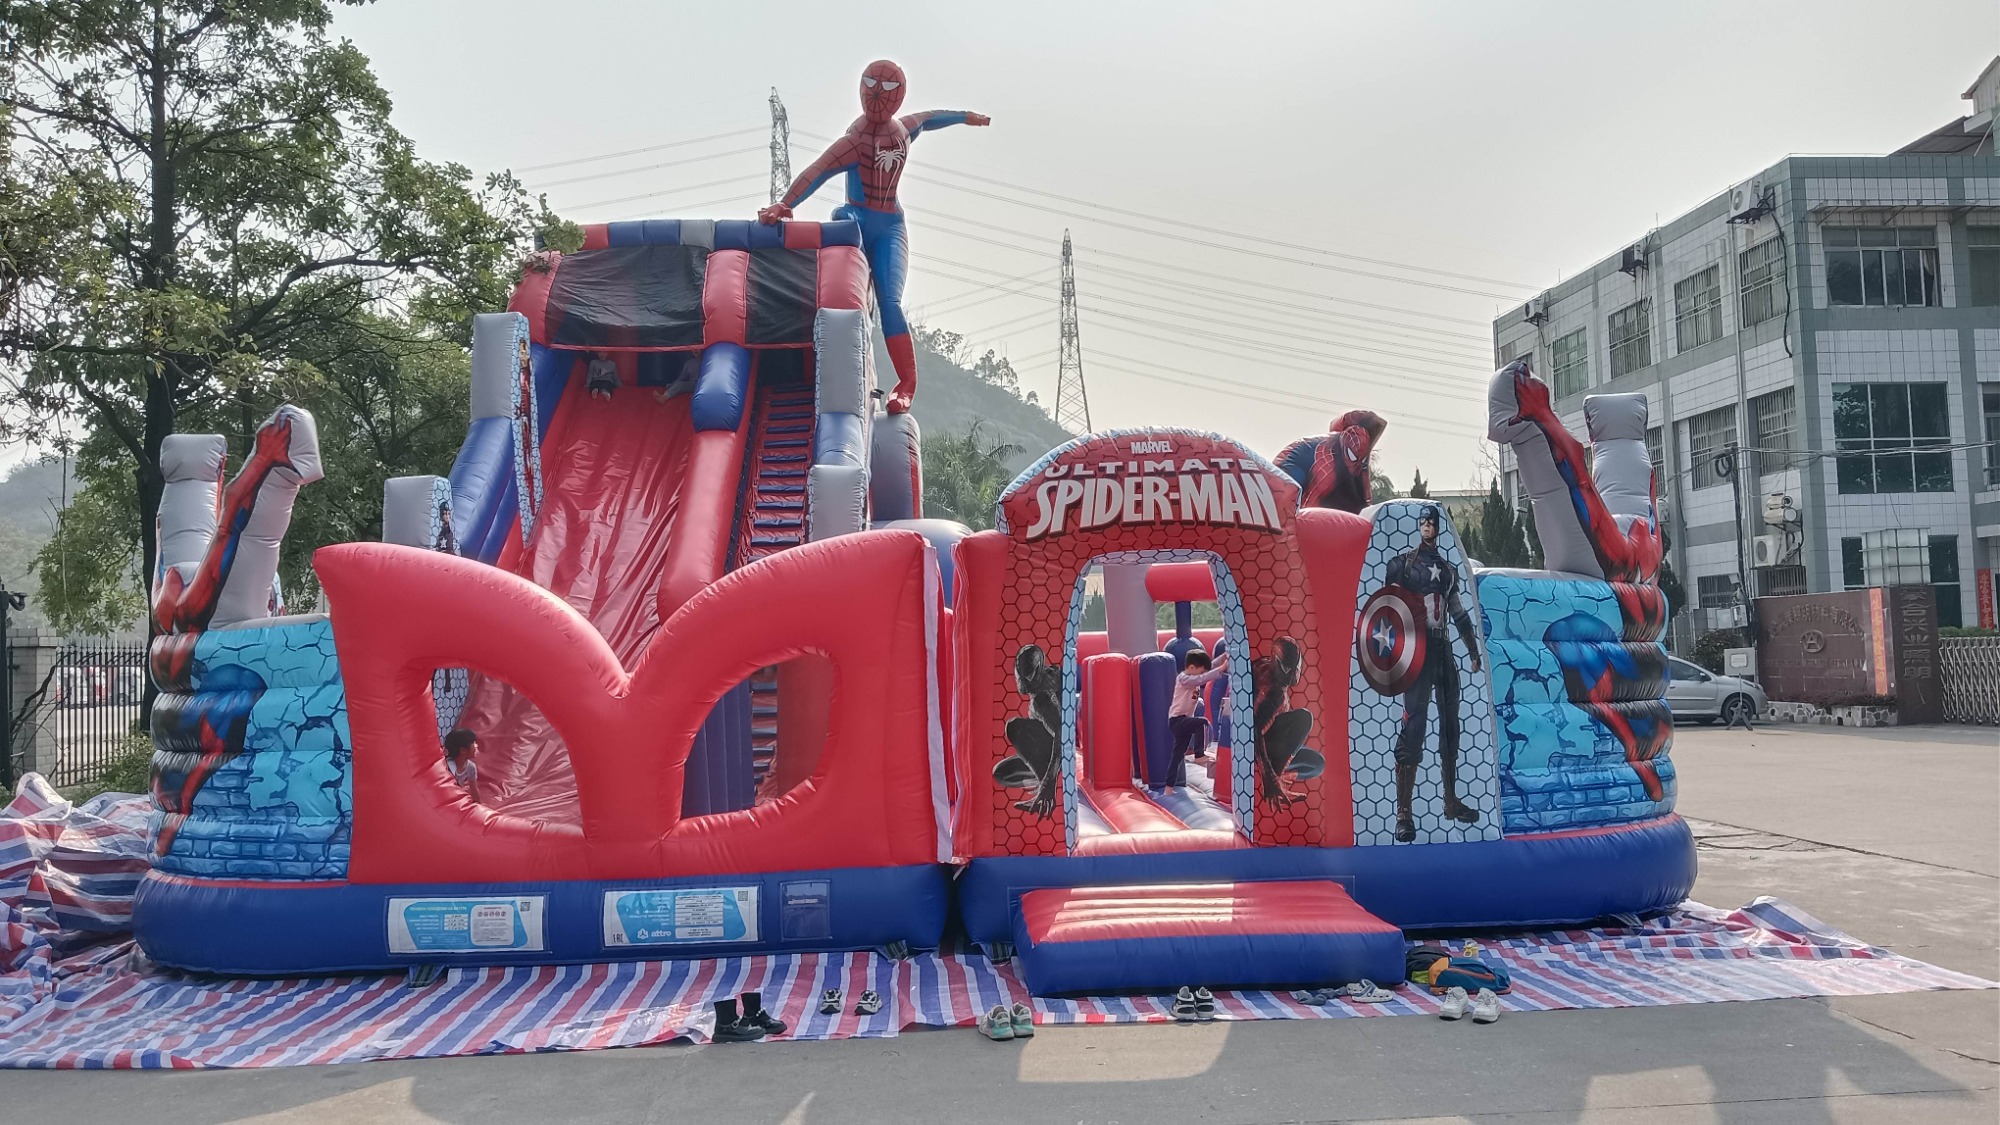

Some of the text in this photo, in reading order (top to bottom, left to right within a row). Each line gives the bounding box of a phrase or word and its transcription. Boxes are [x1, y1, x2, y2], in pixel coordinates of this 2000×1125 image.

[1131, 441, 1173, 455] MARVEL
[1044, 458, 1260, 478] ULTIMATE
[1026, 473, 1282, 540] SPIDER-MAN
[651, 930, 672, 938] attro
